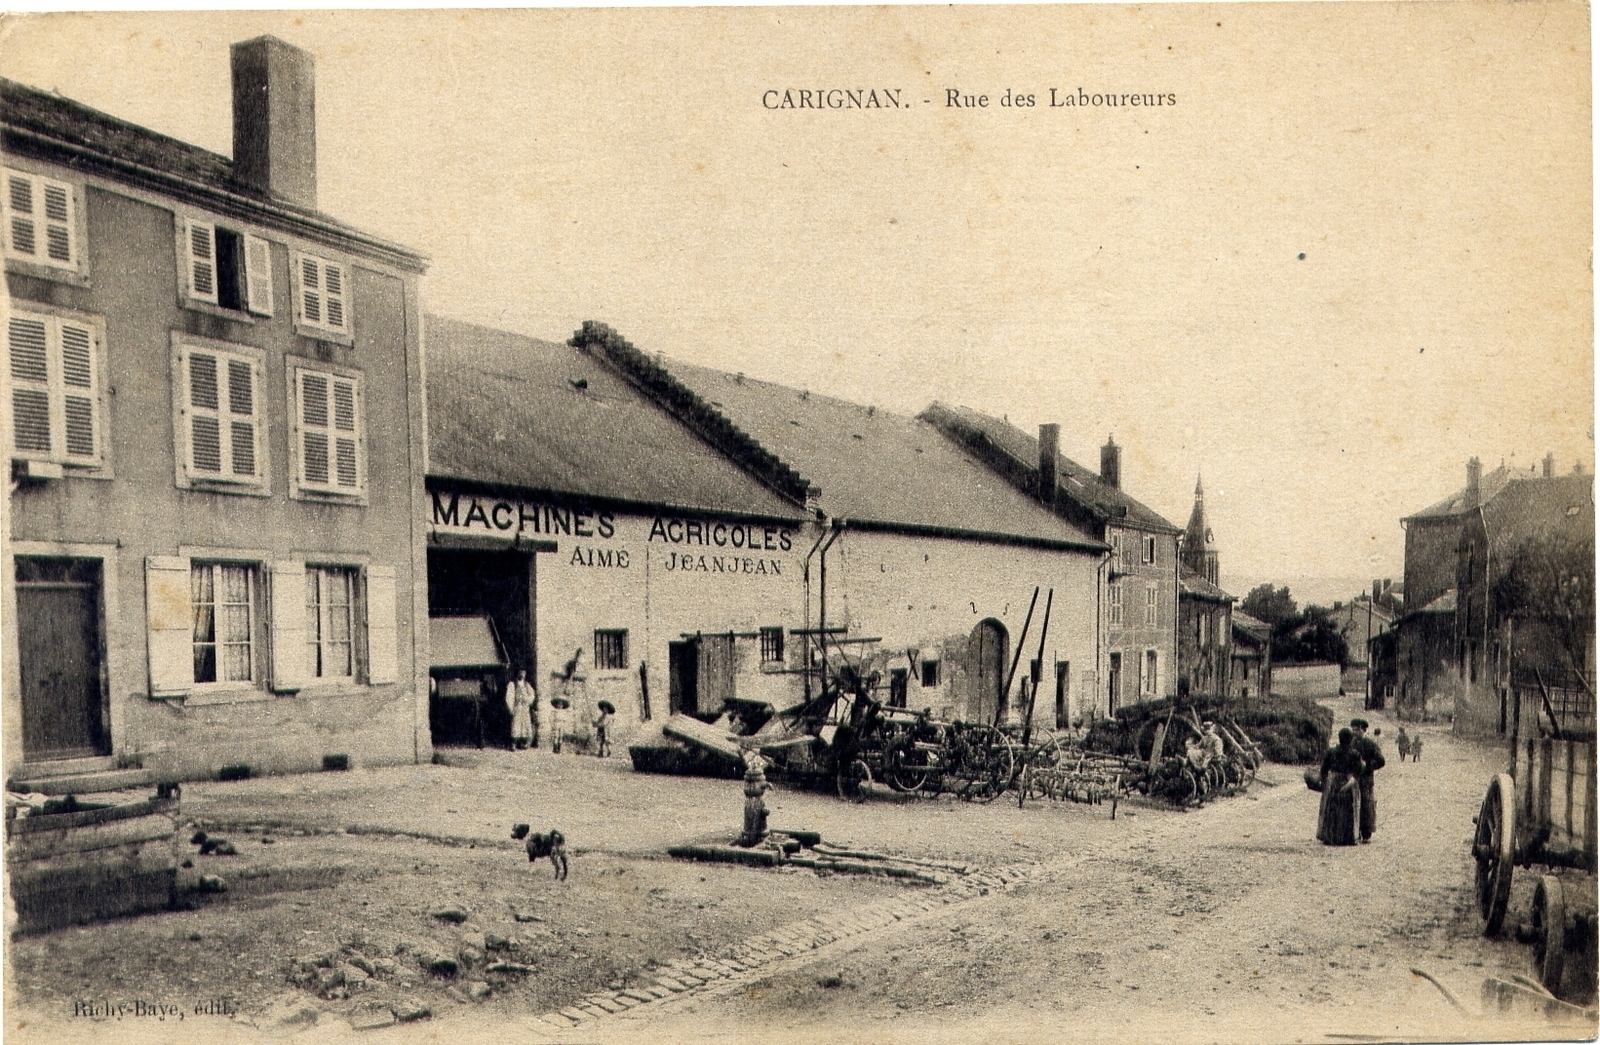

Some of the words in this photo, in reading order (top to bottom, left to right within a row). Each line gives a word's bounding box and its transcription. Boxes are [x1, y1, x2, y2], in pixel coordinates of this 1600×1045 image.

[432, 492, 615, 538] MACHINES
[648, 516, 793, 551] AGRICOLES
[664, 552, 782, 574] JEANJEAN
